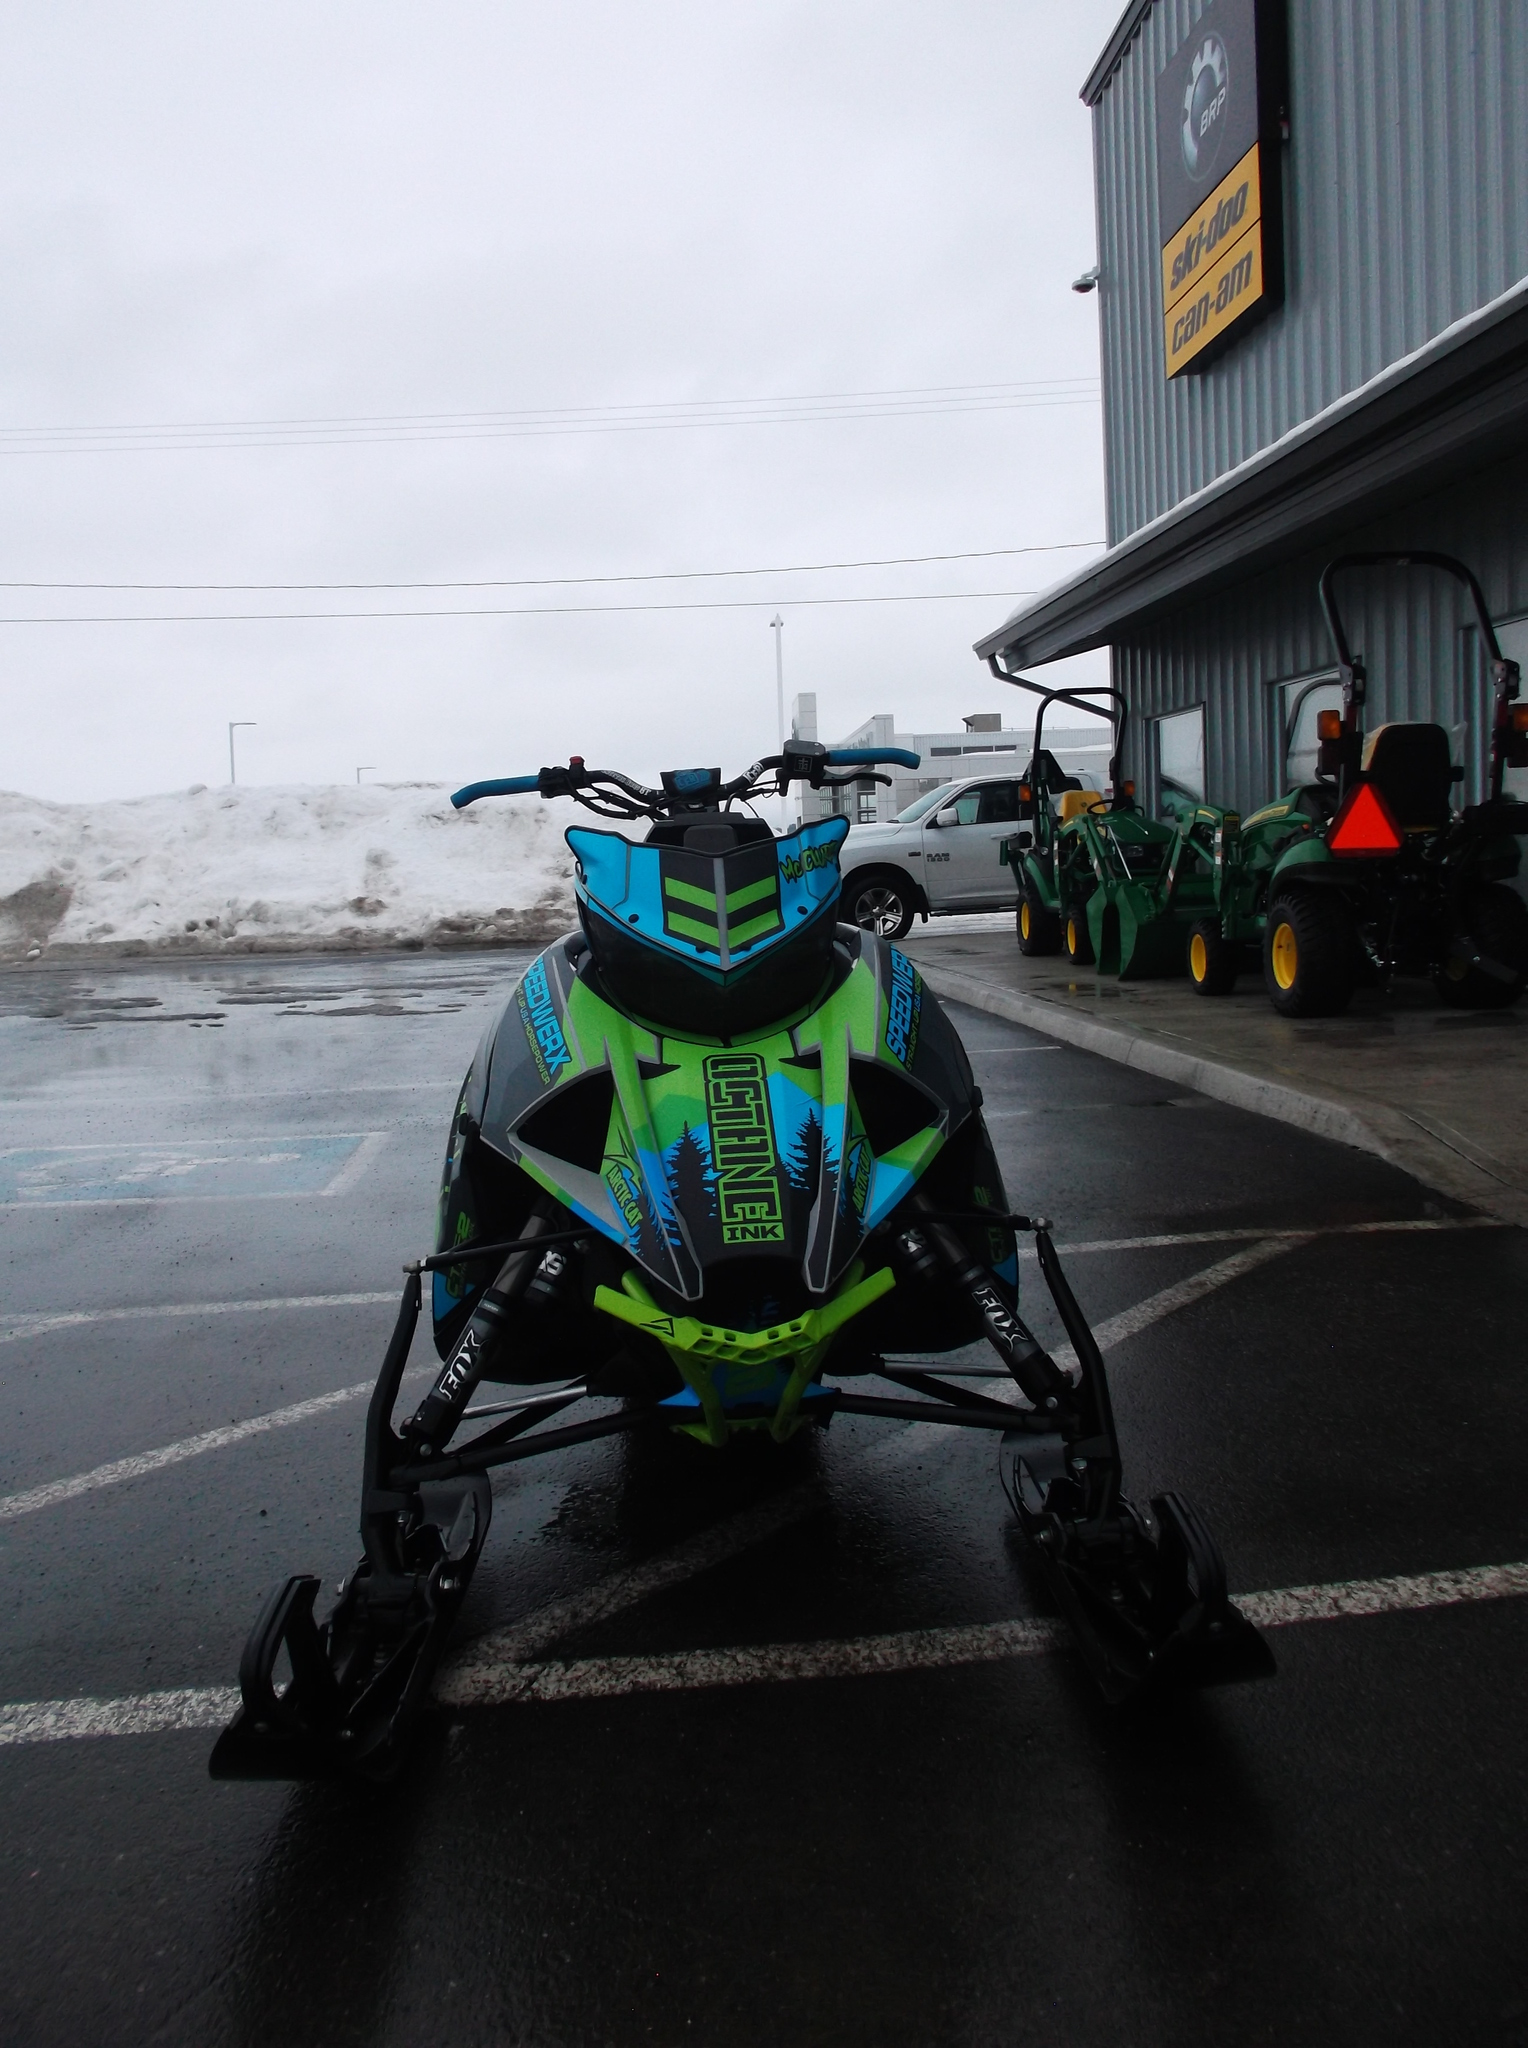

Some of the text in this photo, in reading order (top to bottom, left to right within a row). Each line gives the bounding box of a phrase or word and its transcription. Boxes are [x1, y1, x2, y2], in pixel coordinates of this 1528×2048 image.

[1199, 87, 1226, 137] BRP
[1170, 181, 1248, 291] ski-doo
[1171, 249, 1253, 355] can-am
[520, 1007, 530, 1024] USA
[914, 994, 922, 1012] USA
[524, 1023, 551, 1085] HORSEPOWER
[706, 1054, 783, 1223] OCTANE
[606, 1164, 643, 1228] ARCTIC CAT
[852, 1164, 869, 1213] ARCTIC
[727, 1224, 780, 1241] INK
[971, 1287, 1029, 1353] FOX
[439, 1328, 481, 1402] FOX
